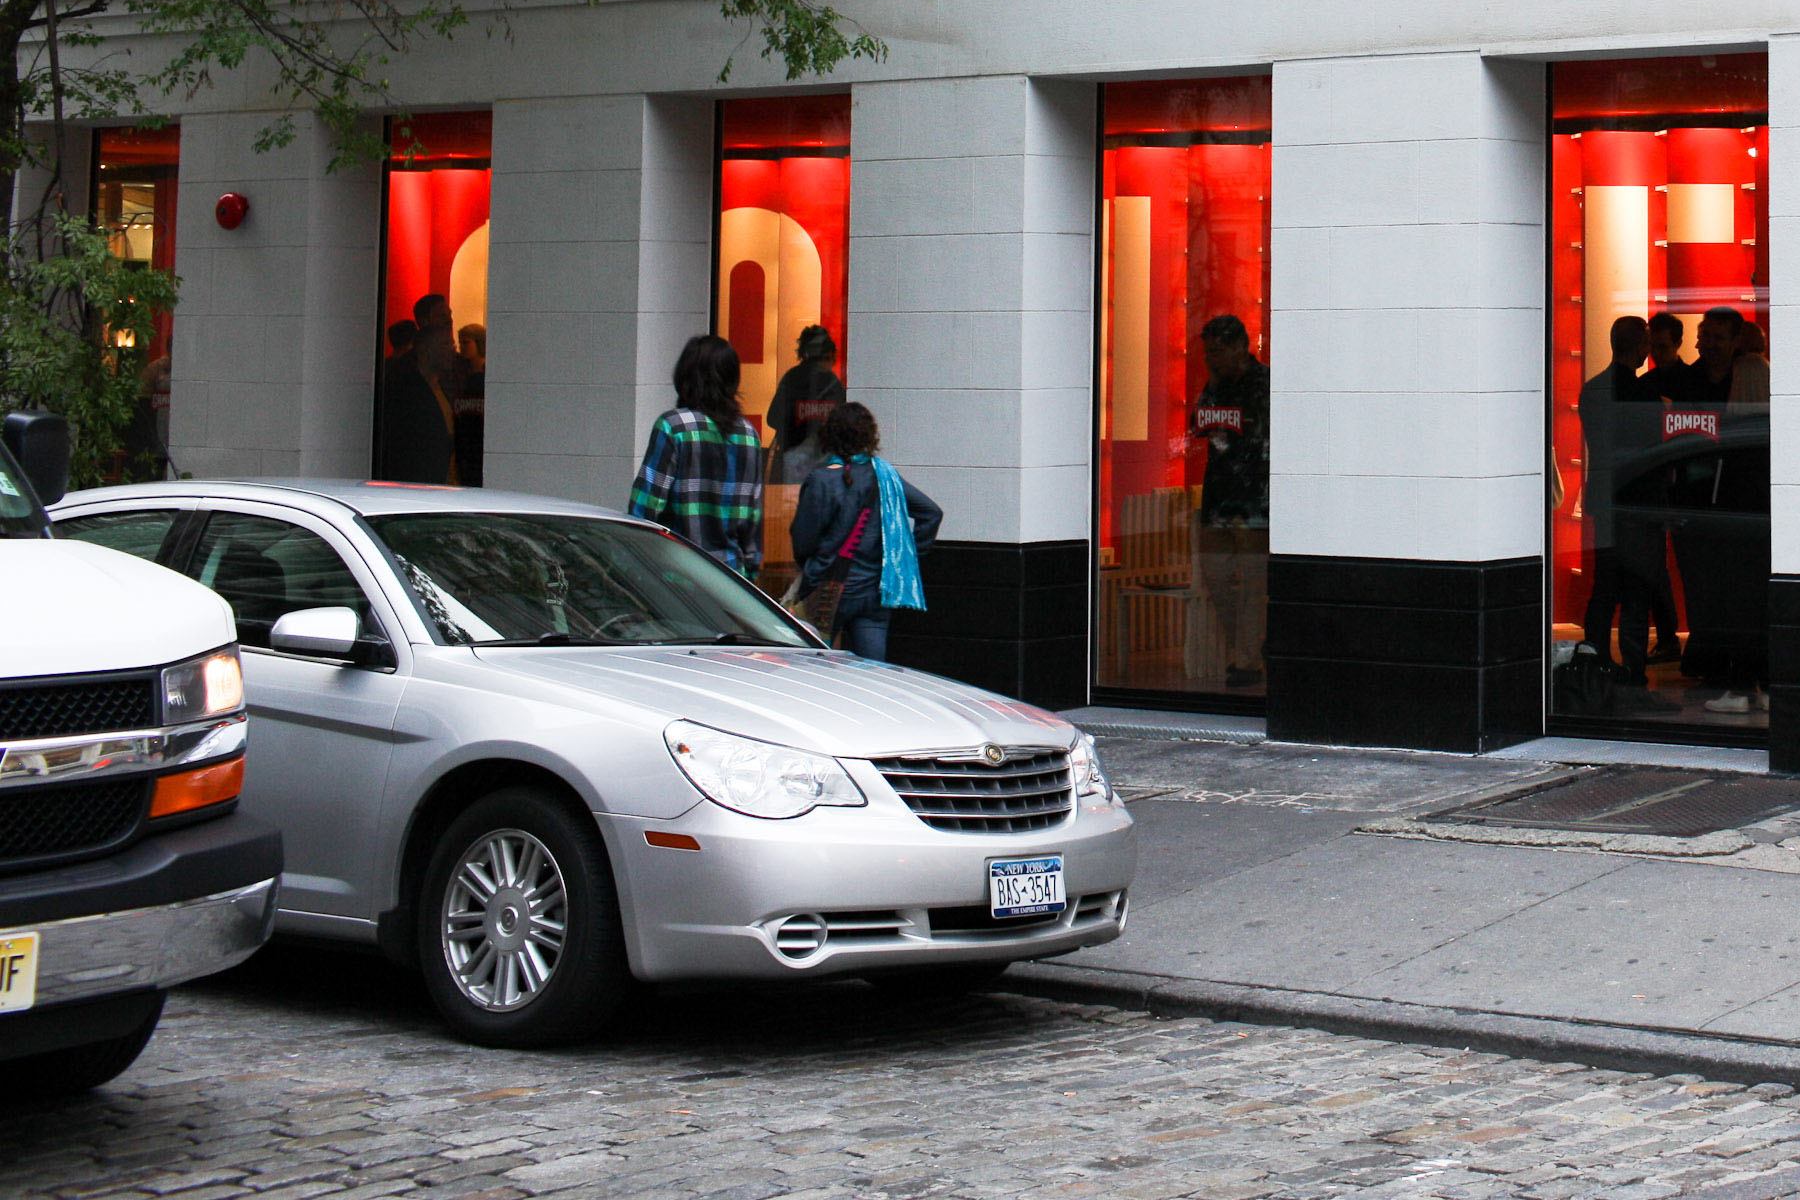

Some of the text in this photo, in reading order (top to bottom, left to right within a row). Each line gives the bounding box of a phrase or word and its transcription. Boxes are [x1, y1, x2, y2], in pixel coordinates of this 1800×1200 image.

[1198, 409, 1240, 430] CAMPER
[1666, 413, 1716, 435] CAMPER
[1007, 861, 1045, 875] NEW YORK
[997, 874, 1057, 907] BAS 3547
